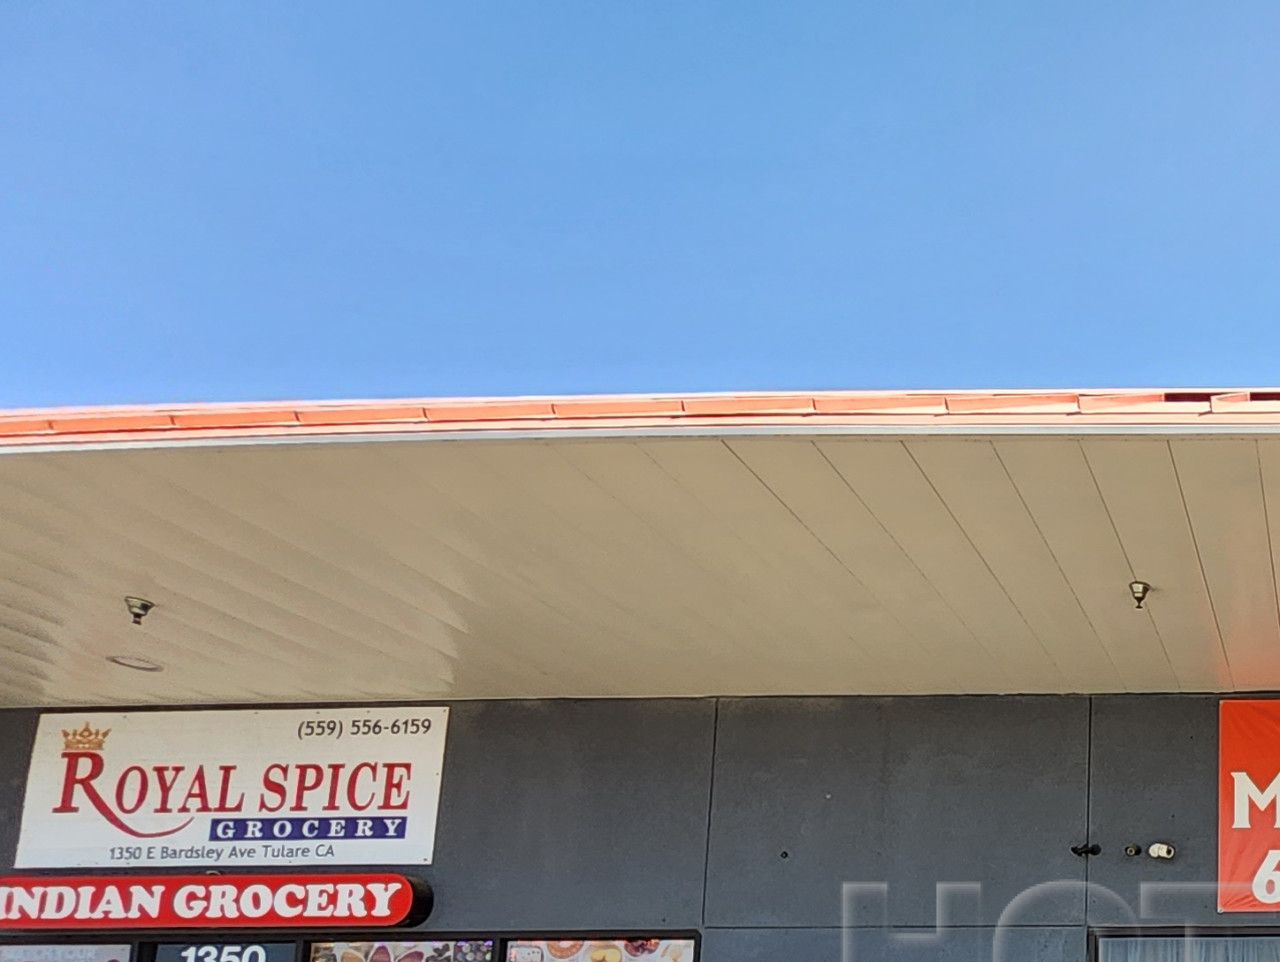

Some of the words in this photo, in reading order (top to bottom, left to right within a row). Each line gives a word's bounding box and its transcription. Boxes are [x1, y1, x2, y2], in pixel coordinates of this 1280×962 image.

[297, 720, 344, 740] (559)
[350, 718, 431, 737] 556-6159
[52, 751, 246, 838] ROYAL
[258, 762, 412, 813] SPICE
[215, 819, 403, 839] GROCERY
[109, 846, 142, 860] 1350
[146, 846, 155, 860] E
[160, 845, 224, 861] Bardsley
[228, 845, 256, 859] Ave
[261, 845, 310, 859] Tulare
[315, 844, 335, 858] CA
[0, 885, 166, 920] INDIAN
[172, 882, 402, 919] GROCERY
